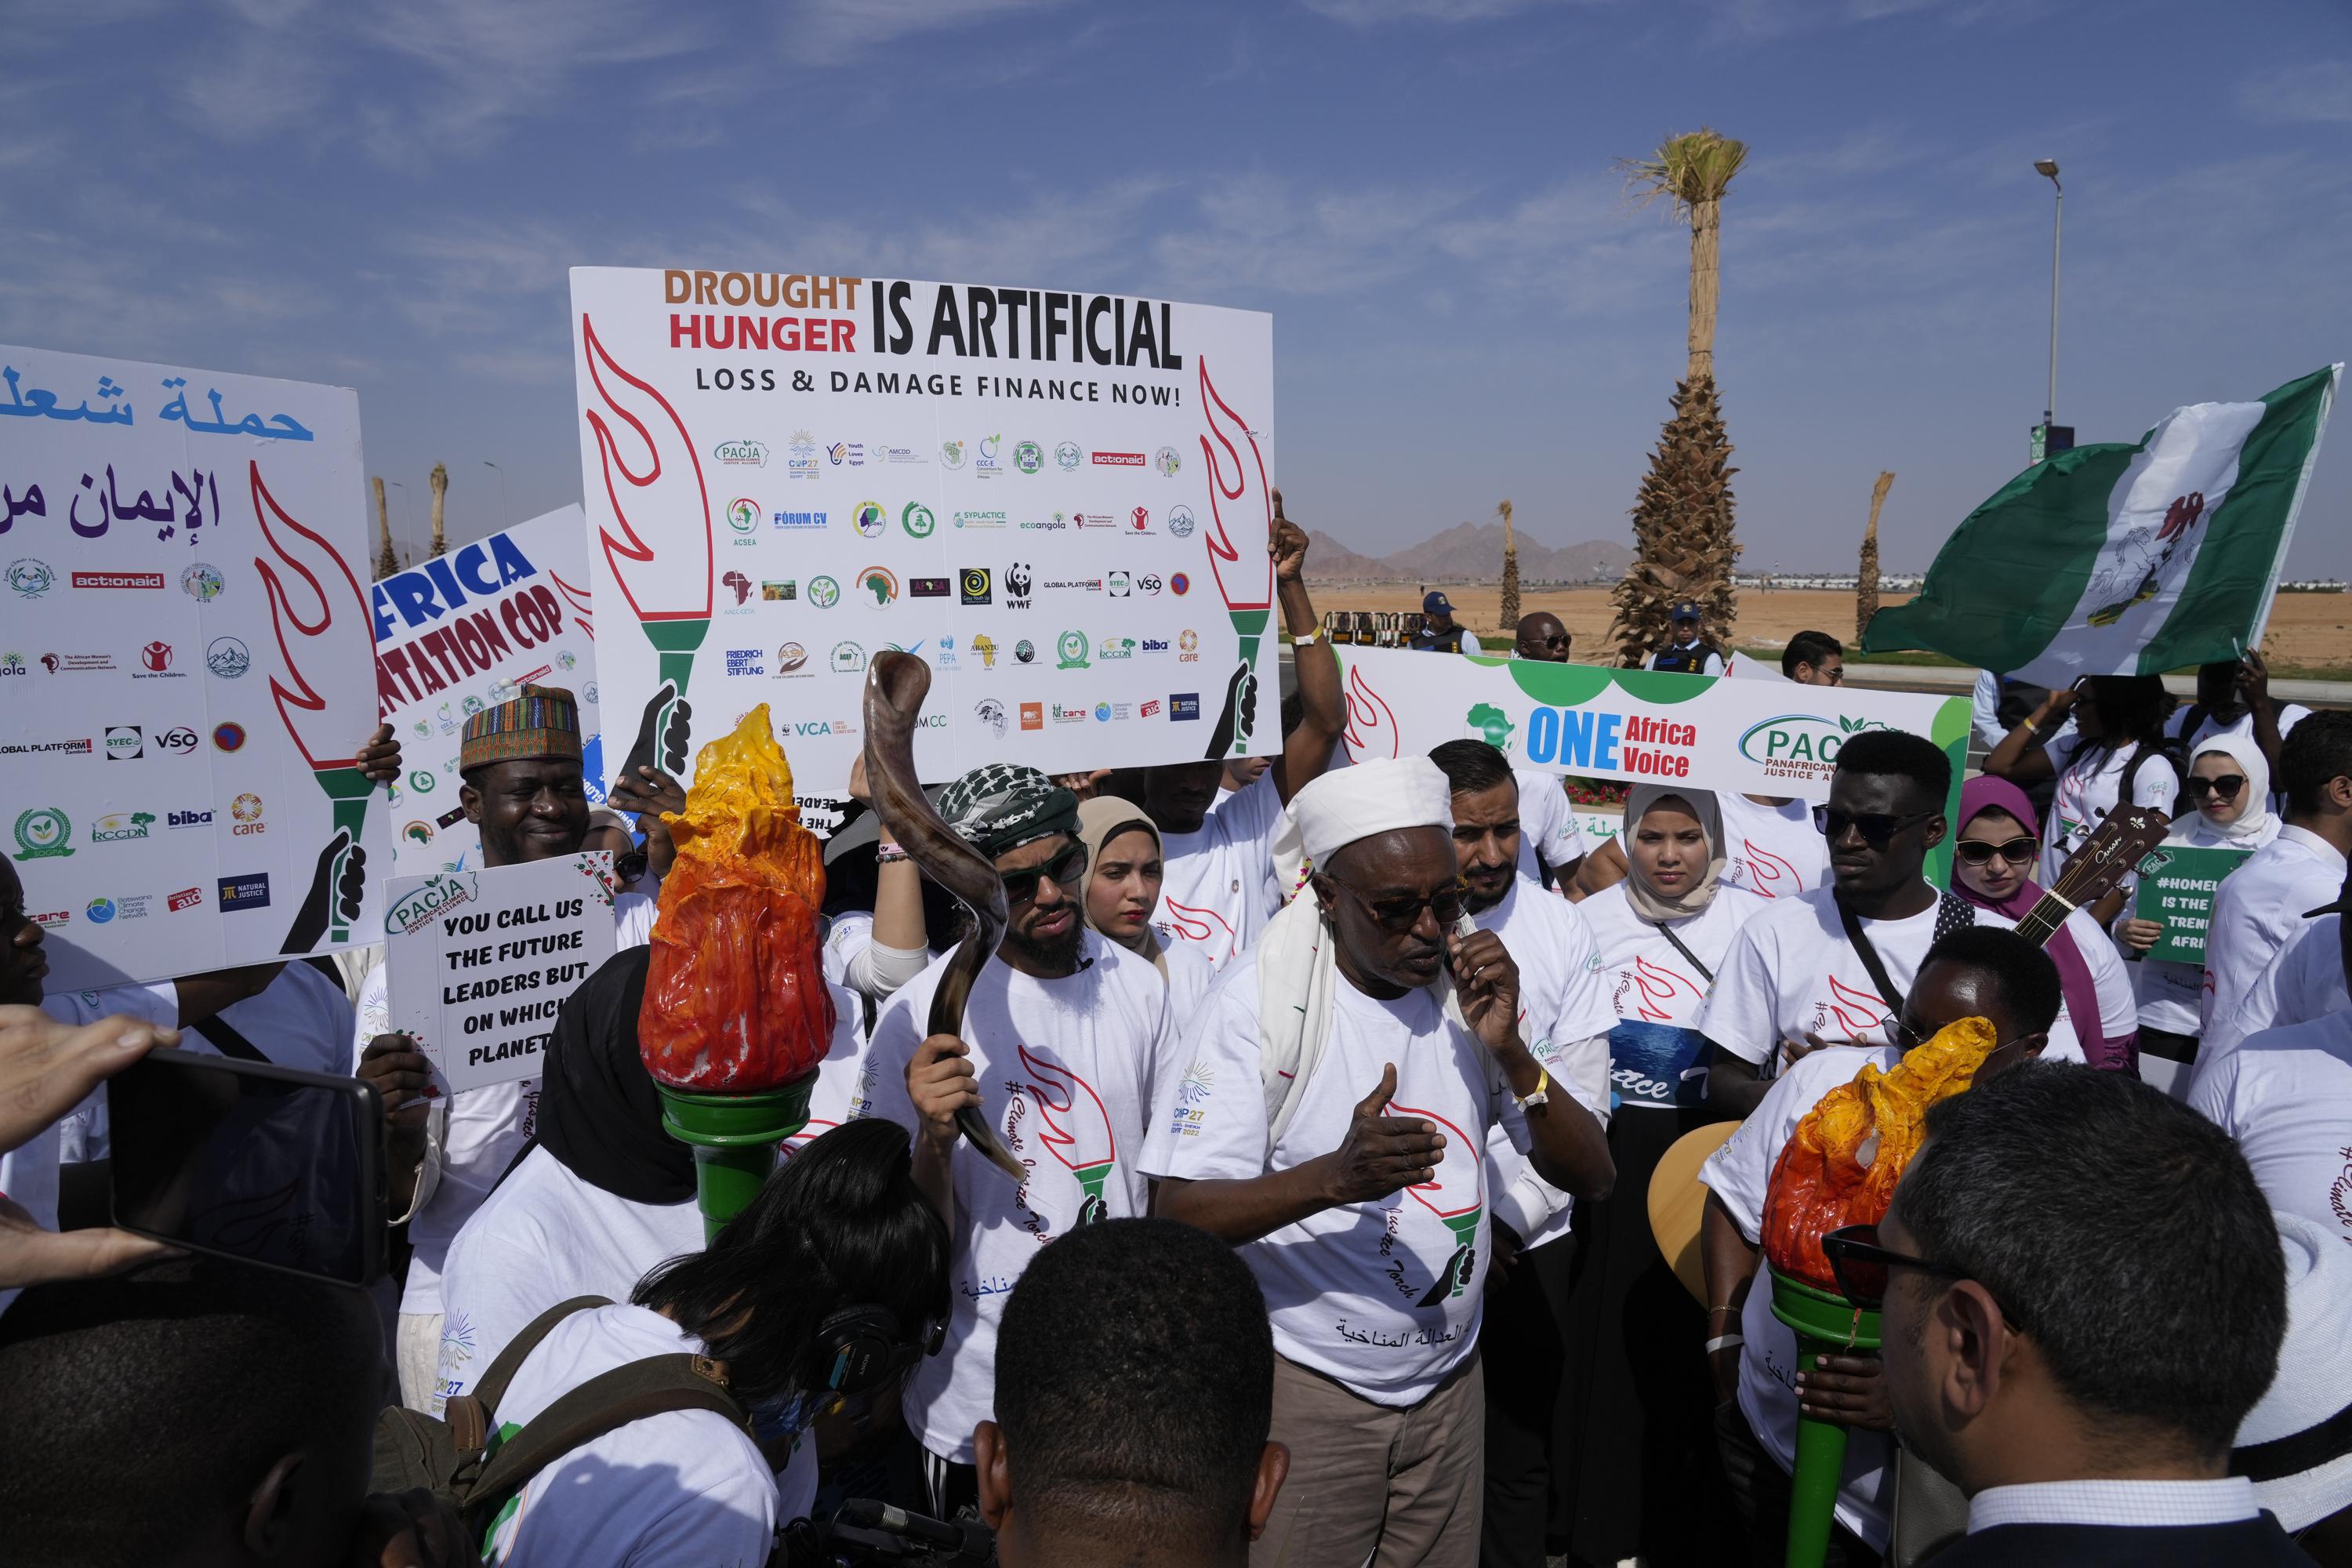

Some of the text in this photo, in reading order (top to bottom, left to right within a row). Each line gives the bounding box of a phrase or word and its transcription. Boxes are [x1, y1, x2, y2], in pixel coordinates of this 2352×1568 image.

[665, 269, 862, 310] DROUGHT
[670, 314, 856, 353] HUNGER
[872, 281, 1182, 371] IS ARTIFICIAL
[696, 368, 1180, 408] LOSS & DAMAGE FINANCE NOW!
[0, 365, 314, 441] حملة شعل
[723, 448, 760, 458] PACJA
[70, 463, 220, 546] الإيمان
[775, 511, 827, 524] FÓRUM CV
[1020, 515, 1066, 530] ecoangola
[76, 575, 161, 587] actionaid
[372, 533, 537, 642] FRICA
[1137, 578, 1162, 590] VSO
[1007, 600, 1032, 609] WWF
[499, 585, 563, 650] COP
[1142, 640, 1168, 650] biba
[726, 649, 763, 659] FRIEDRICH
[939, 653, 956, 664] PEPA
[1179, 653, 1199, 662] care
[727, 659, 748, 667] EBERT
[728, 666, 764, 676] STIFTUNG
[795, 722, 832, 735] VCA
[1624, 715, 1696, 747] Africa
[106, 738, 132, 746] SYEC
[154, 730, 198, 748] VSO
[1527, 706, 1621, 771] ONE
[1767, 730, 1842, 764] PAC
[1624, 746, 1690, 778] Voice
[1766, 758, 1836, 772] PANAFRICAN
[1764, 768, 1813, 780] JUSTICE
[167, 811, 212, 826] biba
[806, 818, 833, 829] THE
[233, 822, 265, 836] care
[238, 883, 266, 891] NATURAL
[238, 889, 263, 898] JUSTICE
[118, 895, 153, 903] Botswana
[176, 889, 202, 909] aid
[396, 879, 464, 927] PACJA
[2161, 896, 2209, 910] IS THE
[118, 911, 148, 920] Network
[405, 890, 467, 931] PANAFRICAN CLIMATE
[408, 895, 470, 936] JUSTICE ALLIANCE
[444, 899, 583, 936] YOU CALL US
[446, 930, 583, 970] THE FUTURE
[2171, 935, 2205, 949] AFRI
[443, 962, 589, 1005] LEADERS BUT
[1612, 970, 1632, 1015] #Climate
[463, 1013, 493, 1034] ON
[1004, 1080, 1025, 1152] #Climate
[1023, 1211, 1058, 1246] Torch
[1385, 1259, 1421, 1298] Torch
[1336, 1319, 1461, 1348] العدالة المناخية
